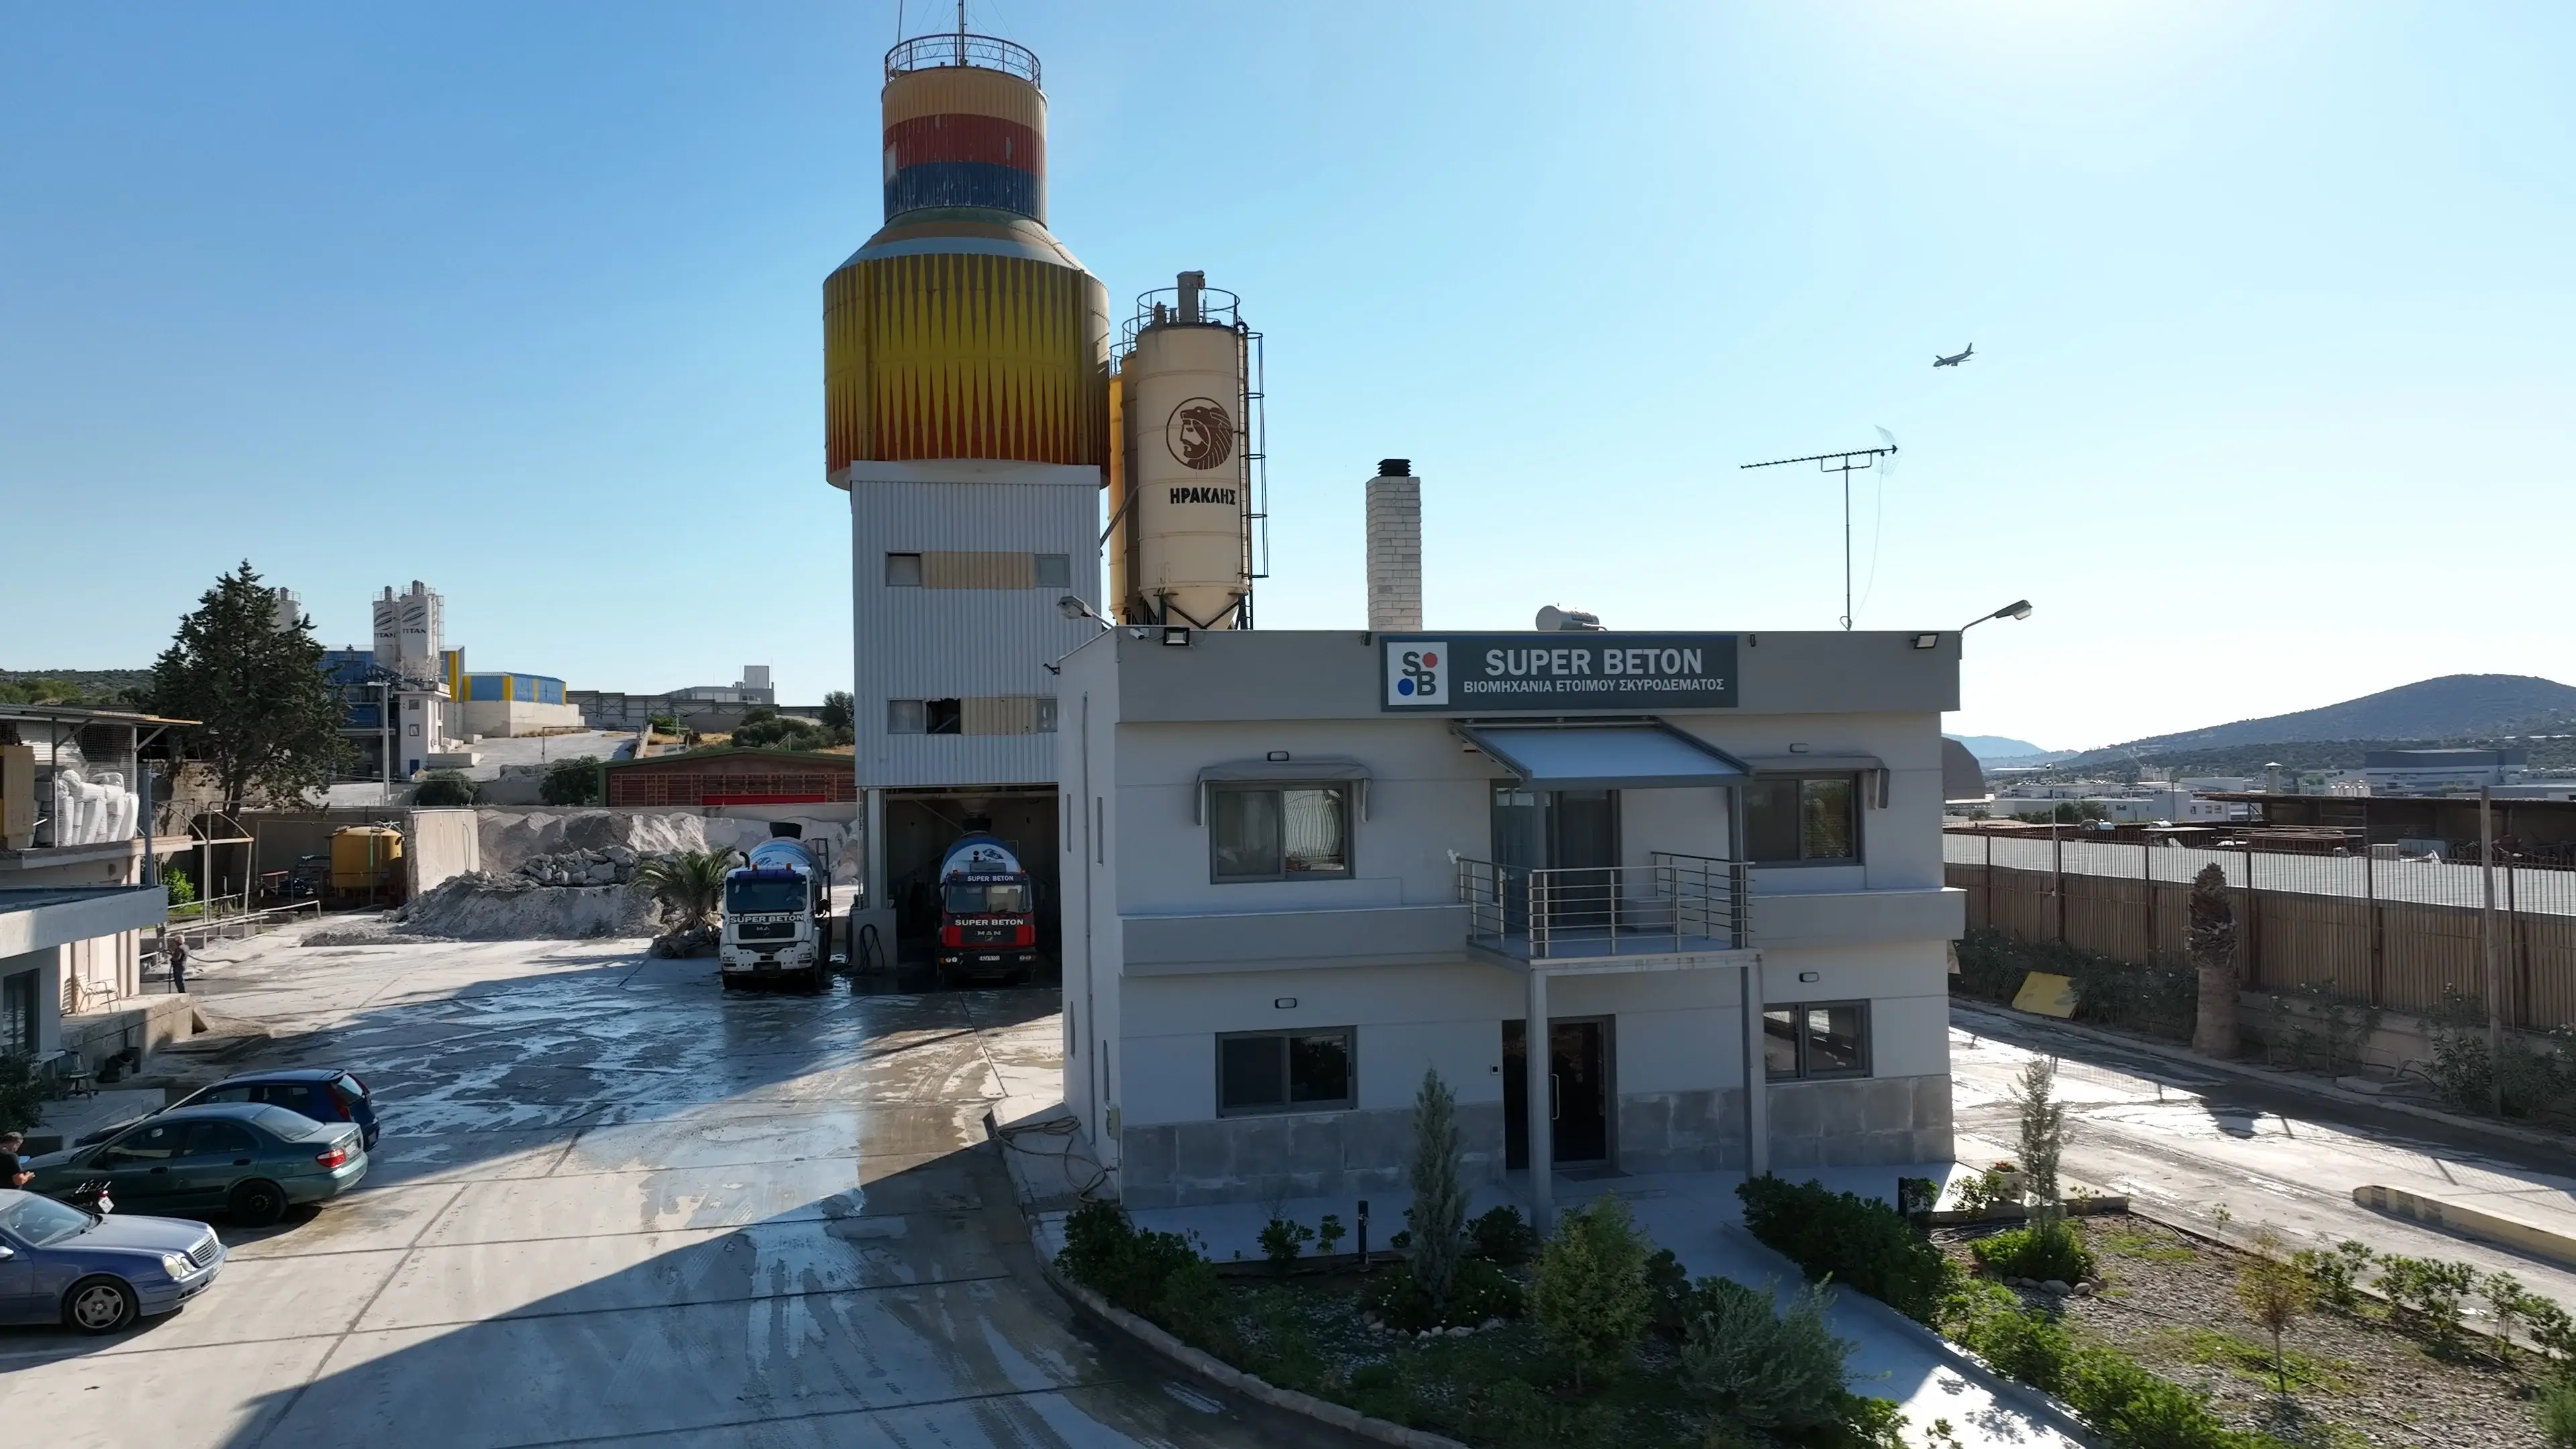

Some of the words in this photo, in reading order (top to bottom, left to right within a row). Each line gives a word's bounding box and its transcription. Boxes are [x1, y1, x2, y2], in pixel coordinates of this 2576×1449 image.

[1170, 487, 1236, 505] ΗΡΑΚΛΗΣ
[1485, 649, 1592, 676] SUPER
[1603, 648, 1702, 675] BETON
[1464, 680, 1553, 693] ΒΙΟΜΗΧΑΝΙΑ
[1556, 679, 1616, 692] ΕΤΟΙΜΟΥ
[1619, 678, 1725, 692] ΣΚΥΡΟΔΕΜΑΤΟΣ
[730, 916, 766, 924] SUPER
[768, 914, 804, 922] BETON
